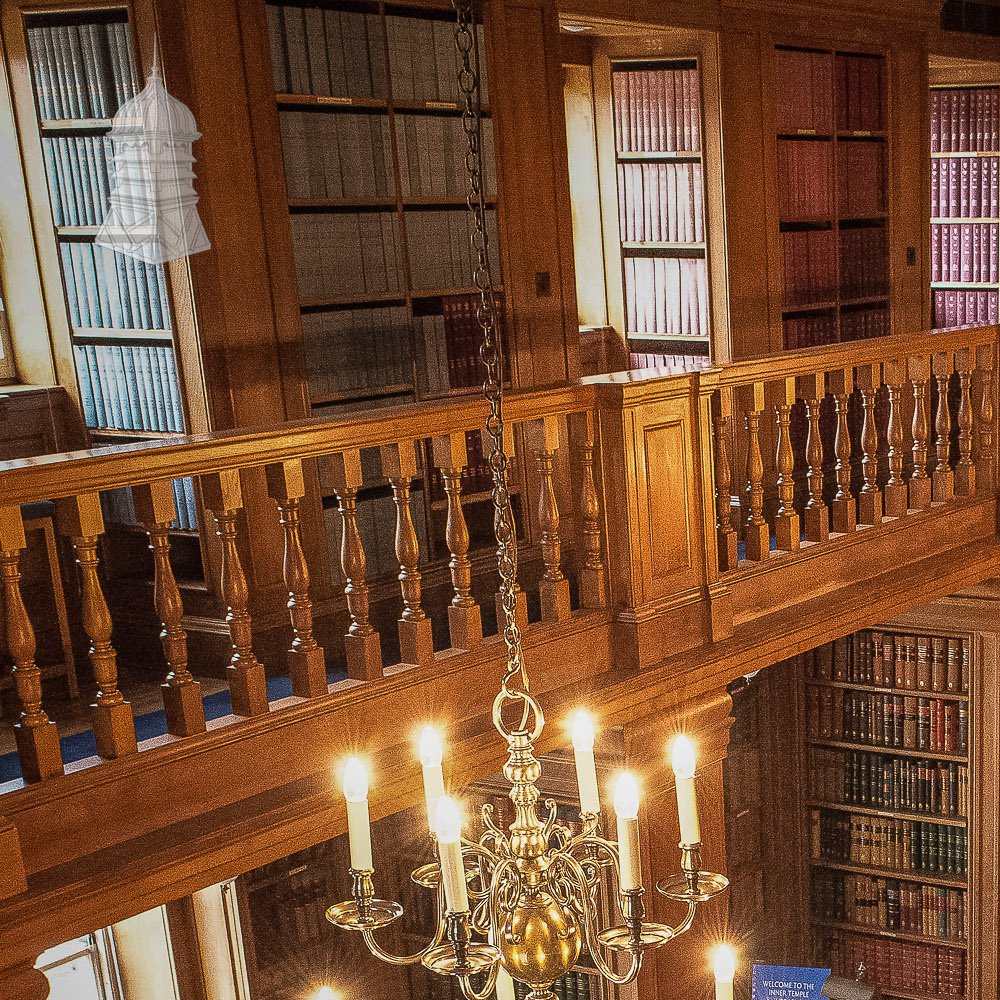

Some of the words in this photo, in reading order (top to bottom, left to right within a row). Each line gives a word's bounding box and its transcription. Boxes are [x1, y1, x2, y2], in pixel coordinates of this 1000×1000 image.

[762, 980, 792, 989] WELCOME
[803, 982, 815, 990] THE
[768, 989, 787, 997] INNER
[788, 990, 810, 998] TEMPLE
